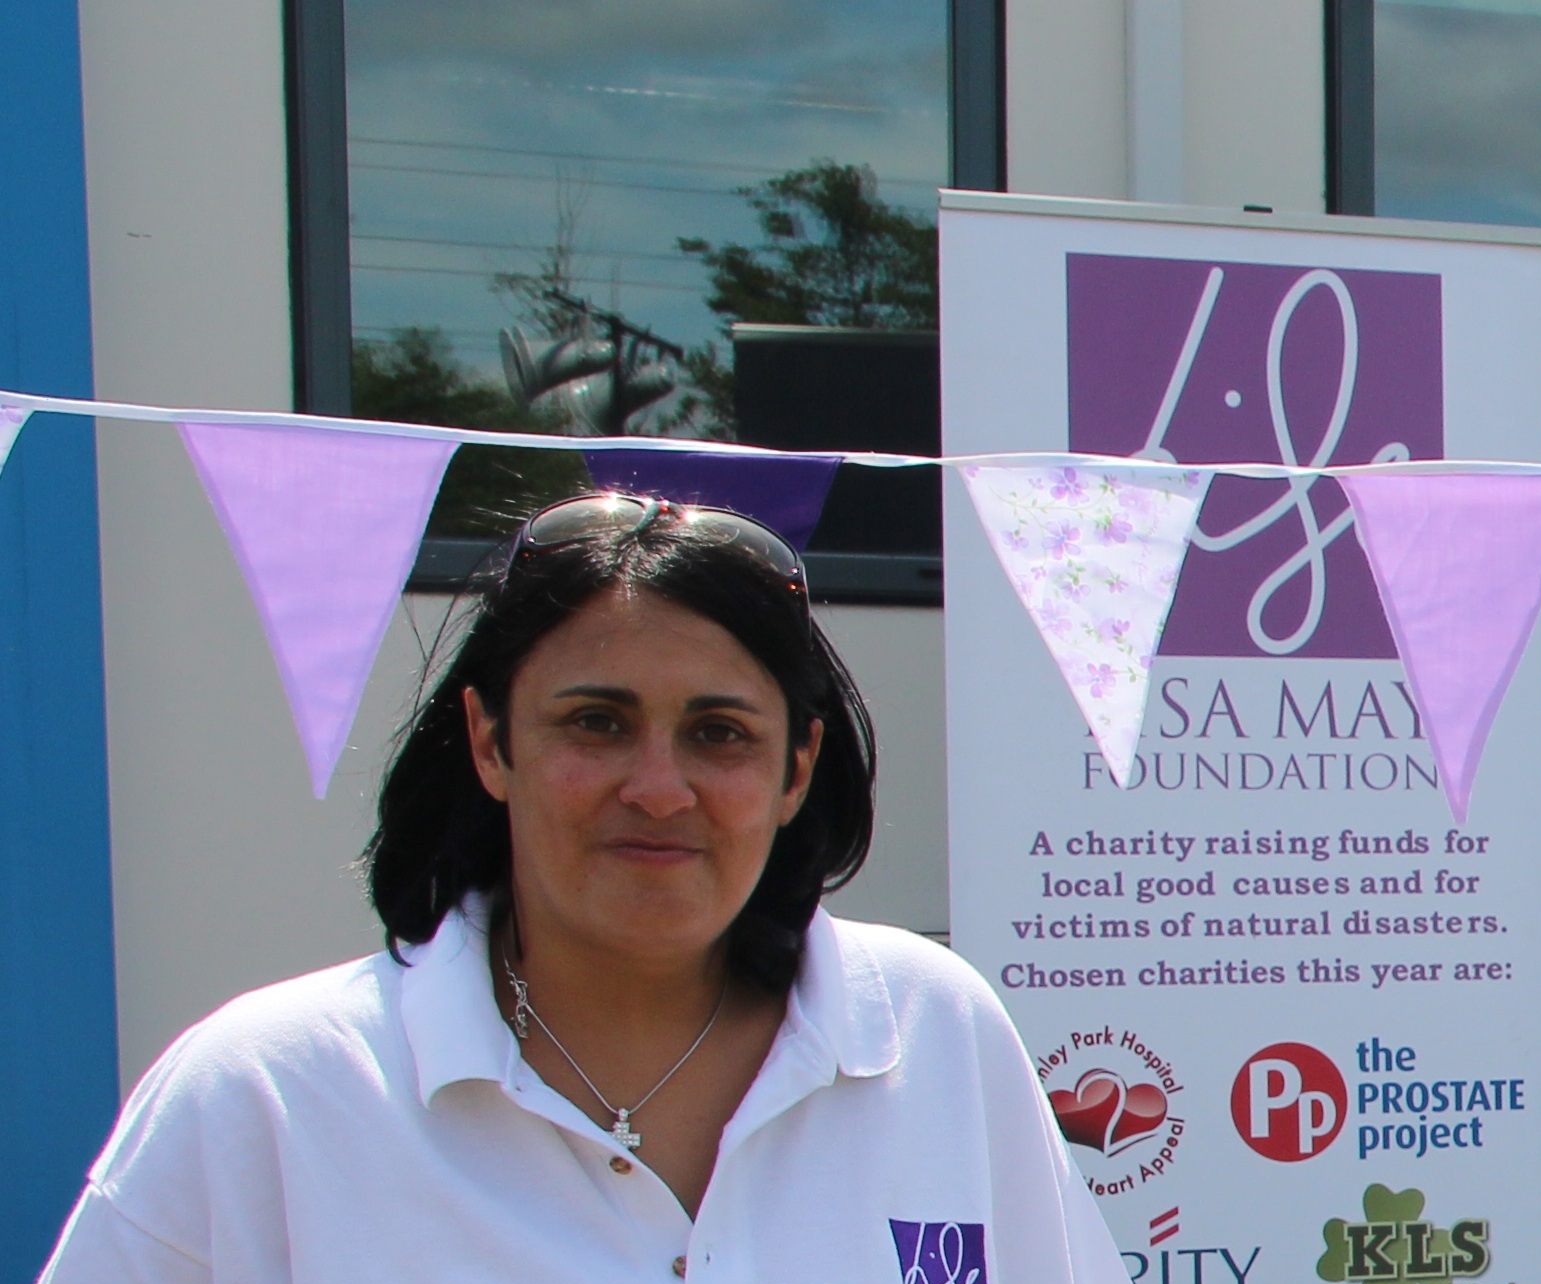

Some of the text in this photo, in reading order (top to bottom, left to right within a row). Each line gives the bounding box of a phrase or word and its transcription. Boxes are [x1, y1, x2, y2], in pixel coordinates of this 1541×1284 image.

[1083, 752, 1437, 790] FOUNDATION
[1030, 829, 1490, 861] A charity raising funds for
[1042, 869, 1480, 903] local good causes and for
[1012, 910, 1509, 939] victims of natural disasters.
[1001, 958, 1513, 988] Chosen charities this year are:
[1071, 1026, 1114, 1050] Park
[1120, 1030, 1184, 1094] Hospital
[1357, 1038, 1416, 1072] the
[1358, 1080, 1524, 1114] PROSTATE
[1140, 1117, 1185, 1182] Appeal
[1358, 1116, 1483, 1159] project
[1345, 1220, 1489, 1280] KLS
